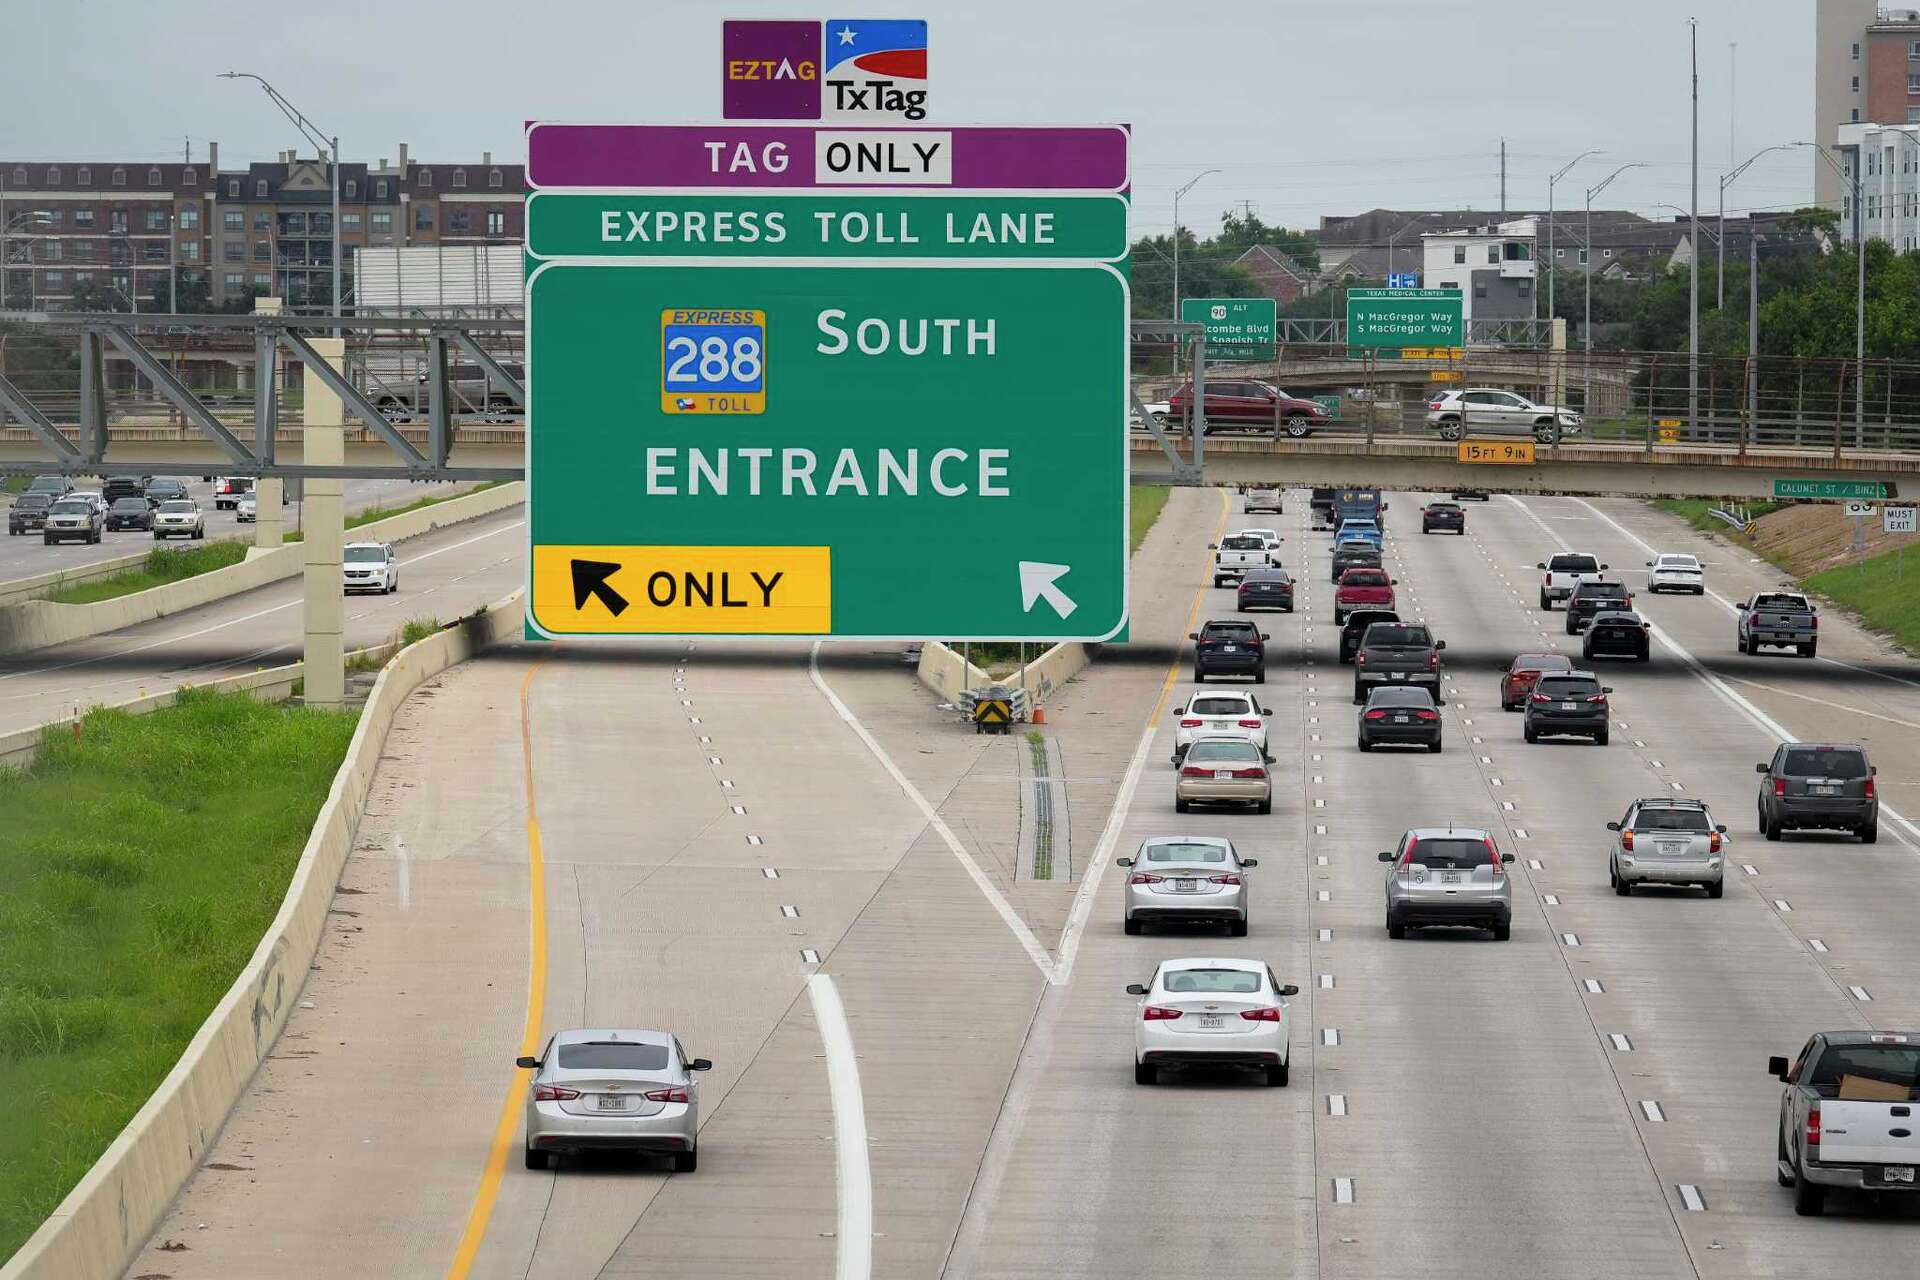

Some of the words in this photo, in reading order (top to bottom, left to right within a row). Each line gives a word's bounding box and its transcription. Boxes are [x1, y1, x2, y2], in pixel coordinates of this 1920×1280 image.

[729, 57, 816, 80] EZTAG
[826, 80, 927, 120] TxTag
[705, 142, 789, 173] TAG
[826, 143, 941, 174] ONLY
[601, 211, 787, 243] EXPRESS
[815, 212, 919, 243] TOLL
[946, 213, 1055, 244] LANE
[672, 311, 754, 324] EXPRESS
[1212, 308, 1225, 317] 90
[1369, 313, 1425, 322] MacGregor
[1431, 313, 1453, 322] Way
[816, 308, 997, 356] SOUTH
[1204, 324, 1241, 333] combe
[1247, 324, 1269, 333] Blvd
[1369, 325, 1425, 334] MacGregor
[1431, 325, 1453, 334] Way
[1212, 336, 1253, 344] Spanish
[1258, 336, 1269, 344] Tr
[667, 336, 761, 382] 288
[708, 398, 751, 411] TOLL
[1466, 446, 1480, 458] 15
[1483, 449, 1496, 458] FT
[1504, 446, 1513, 458] 9
[1515, 449, 1525, 458] IN
[646, 447, 1010, 497] ENTRANCE
[1781, 484, 1818, 493] CALUMET
[1825, 485, 1836, 493] ST
[1855, 485, 1875, 495] BINZ
[1887, 510, 1913, 518] MUST
[1890, 522, 1910, 530] EXIT
[647, 572, 783, 607] ONLY
